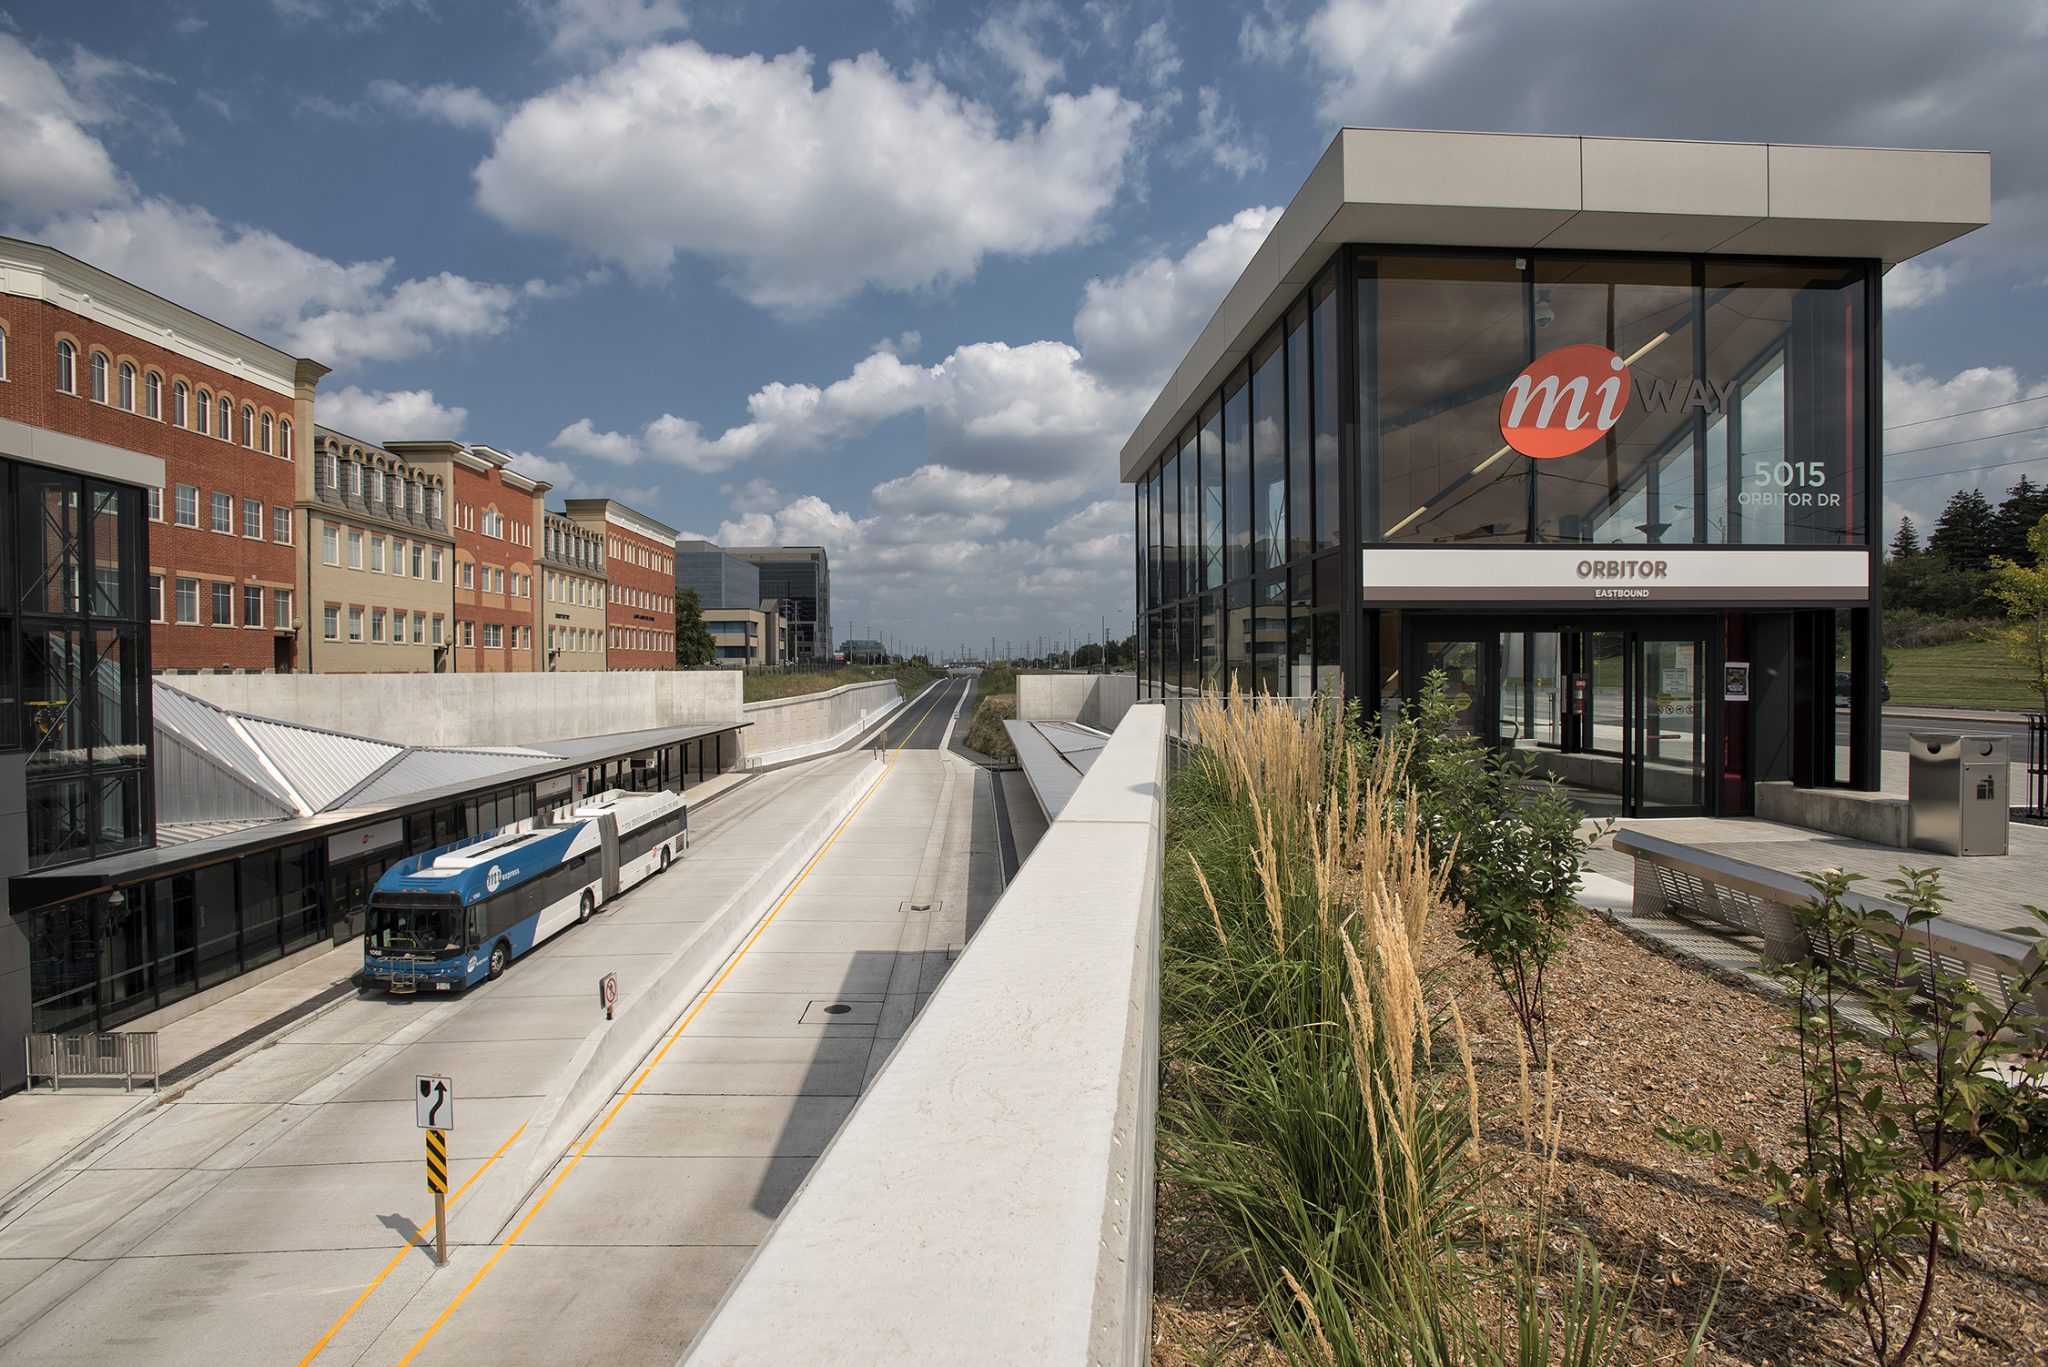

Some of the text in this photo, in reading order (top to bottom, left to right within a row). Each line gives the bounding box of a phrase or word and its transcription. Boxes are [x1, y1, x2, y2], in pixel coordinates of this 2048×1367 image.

[1754, 461, 1826, 487] 5015
[1738, 492, 1841, 507] ORBITOR DR
[1576, 560, 1668, 579] ORBITOR
[1595, 589, 1650, 598] EASTBOUND
[502, 868, 520, 880] express
